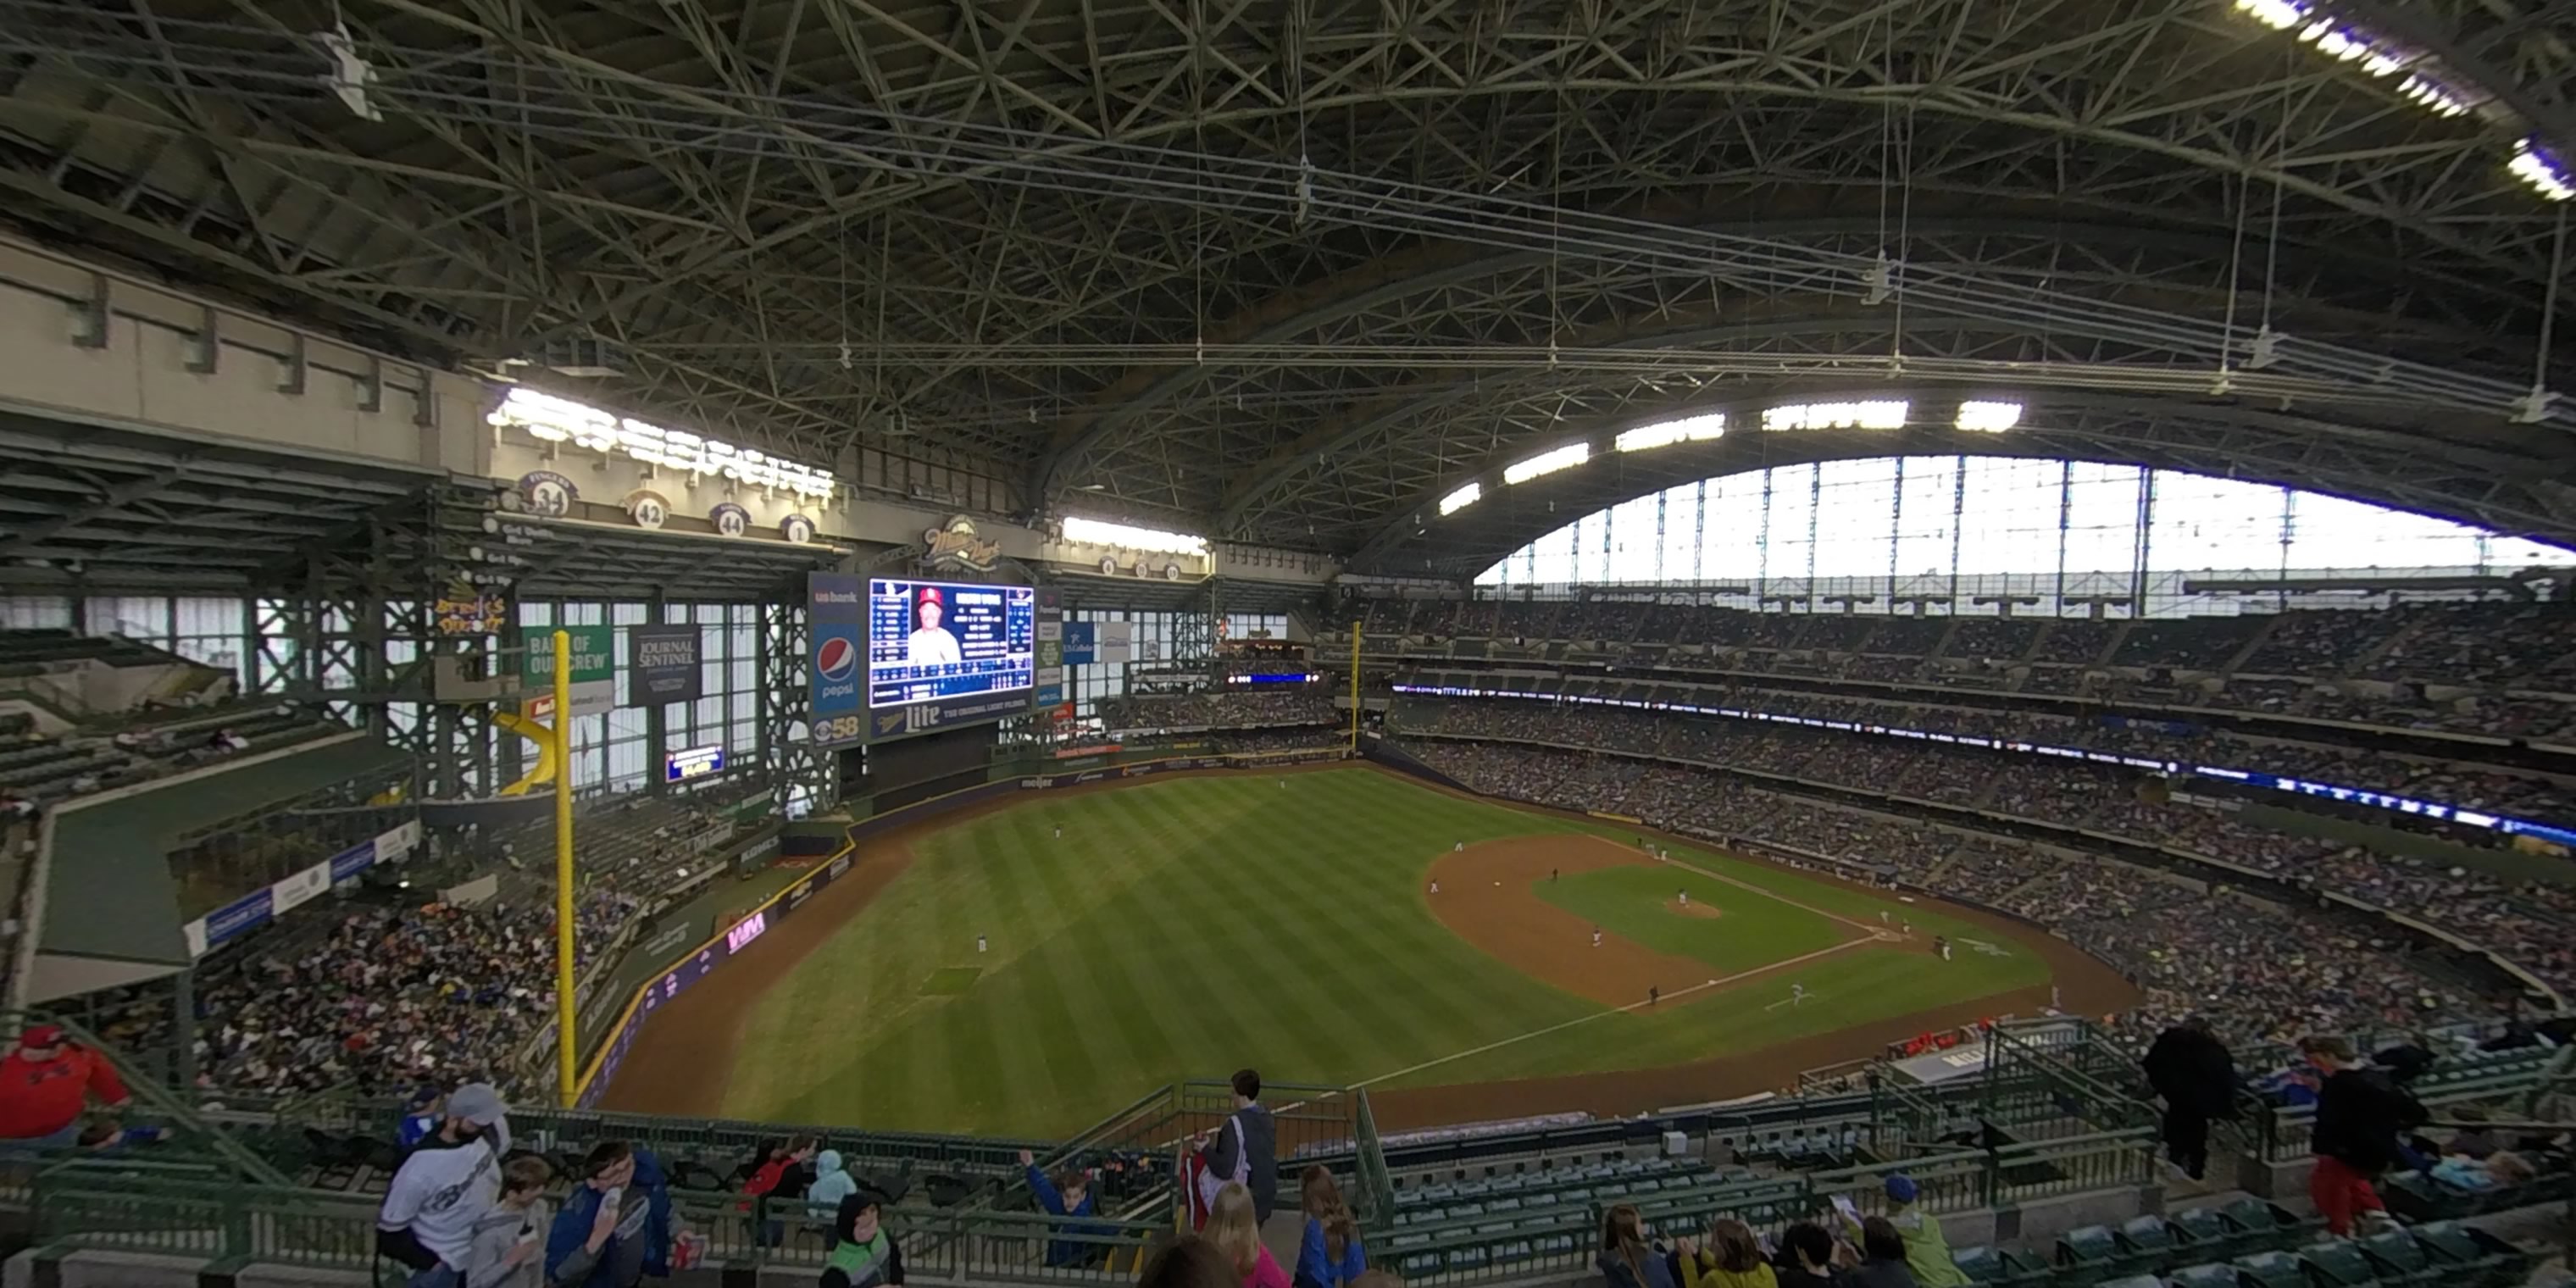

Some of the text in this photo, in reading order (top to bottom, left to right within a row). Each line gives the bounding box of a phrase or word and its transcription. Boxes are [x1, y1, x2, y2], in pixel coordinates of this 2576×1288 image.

[538, 487, 564, 515] 34
[638, 504, 660, 524] 42
[722, 516, 741, 534] 44
[830, 591, 858, 603] bank
[573, 636, 591, 652] OF
[640, 641, 695, 654] JOURNAL
[569, 654, 604, 670] CREW
[639, 652, 695, 668] SENTINEL
[822, 683, 854, 699] pepsi
[831, 715, 859, 740] 58
[904, 706, 941, 733] Lite
